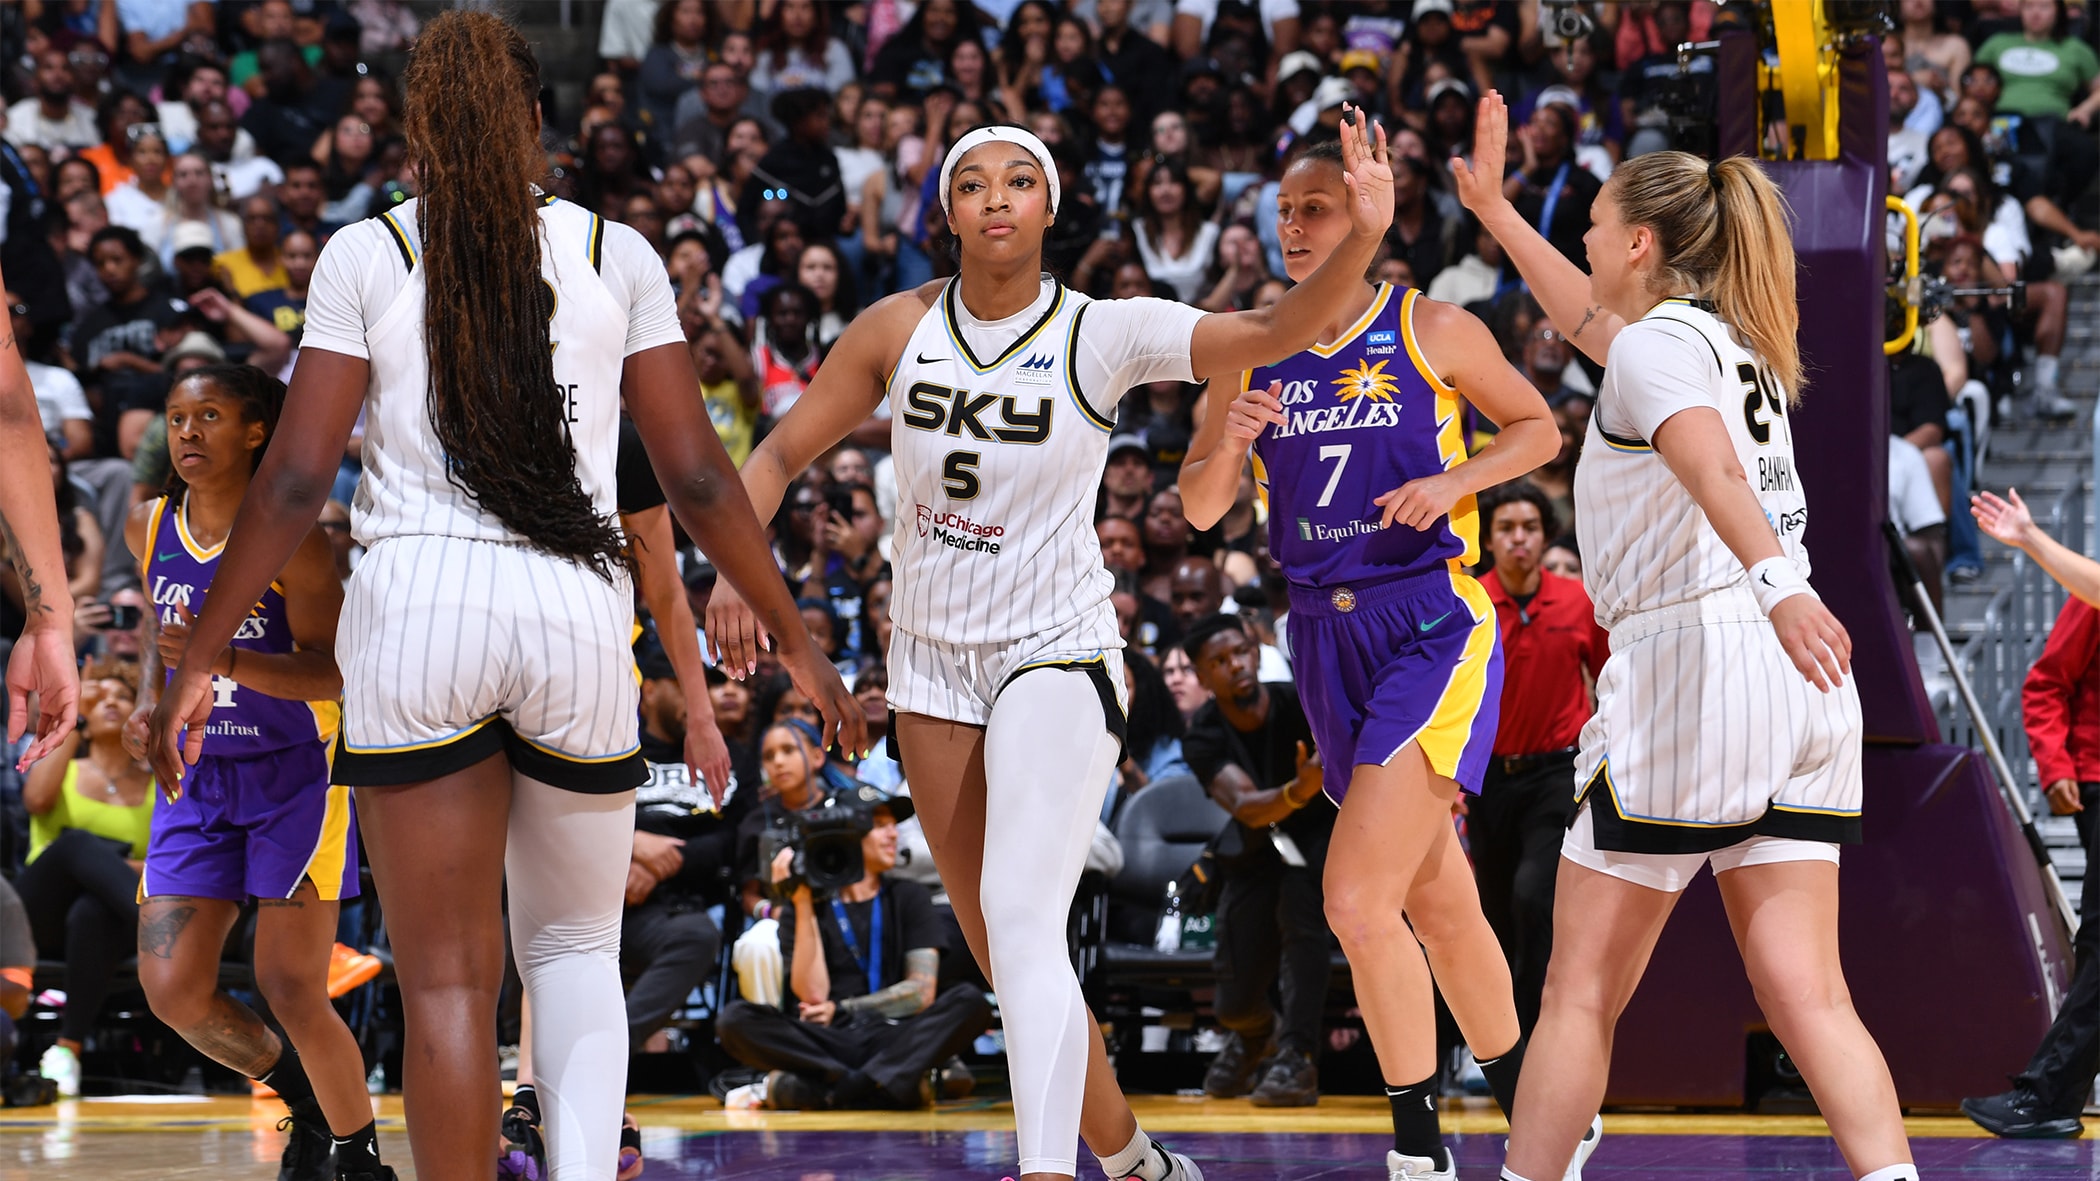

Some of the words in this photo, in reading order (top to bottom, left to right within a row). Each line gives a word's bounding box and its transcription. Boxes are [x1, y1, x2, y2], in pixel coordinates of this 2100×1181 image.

[1366, 345, 1395, 356] Health
[1369, 333, 1392, 343] UCLA
[1015, 370, 1053, 378] MAGELLAN
[903, 379, 1055, 446] SKY
[941, 449, 982, 501] 5
[1316, 444, 1352, 508] 7
[934, 513, 1005, 538] UChicago
[933, 527, 1001, 555] Medicine
[152, 575, 195, 607] LOS
